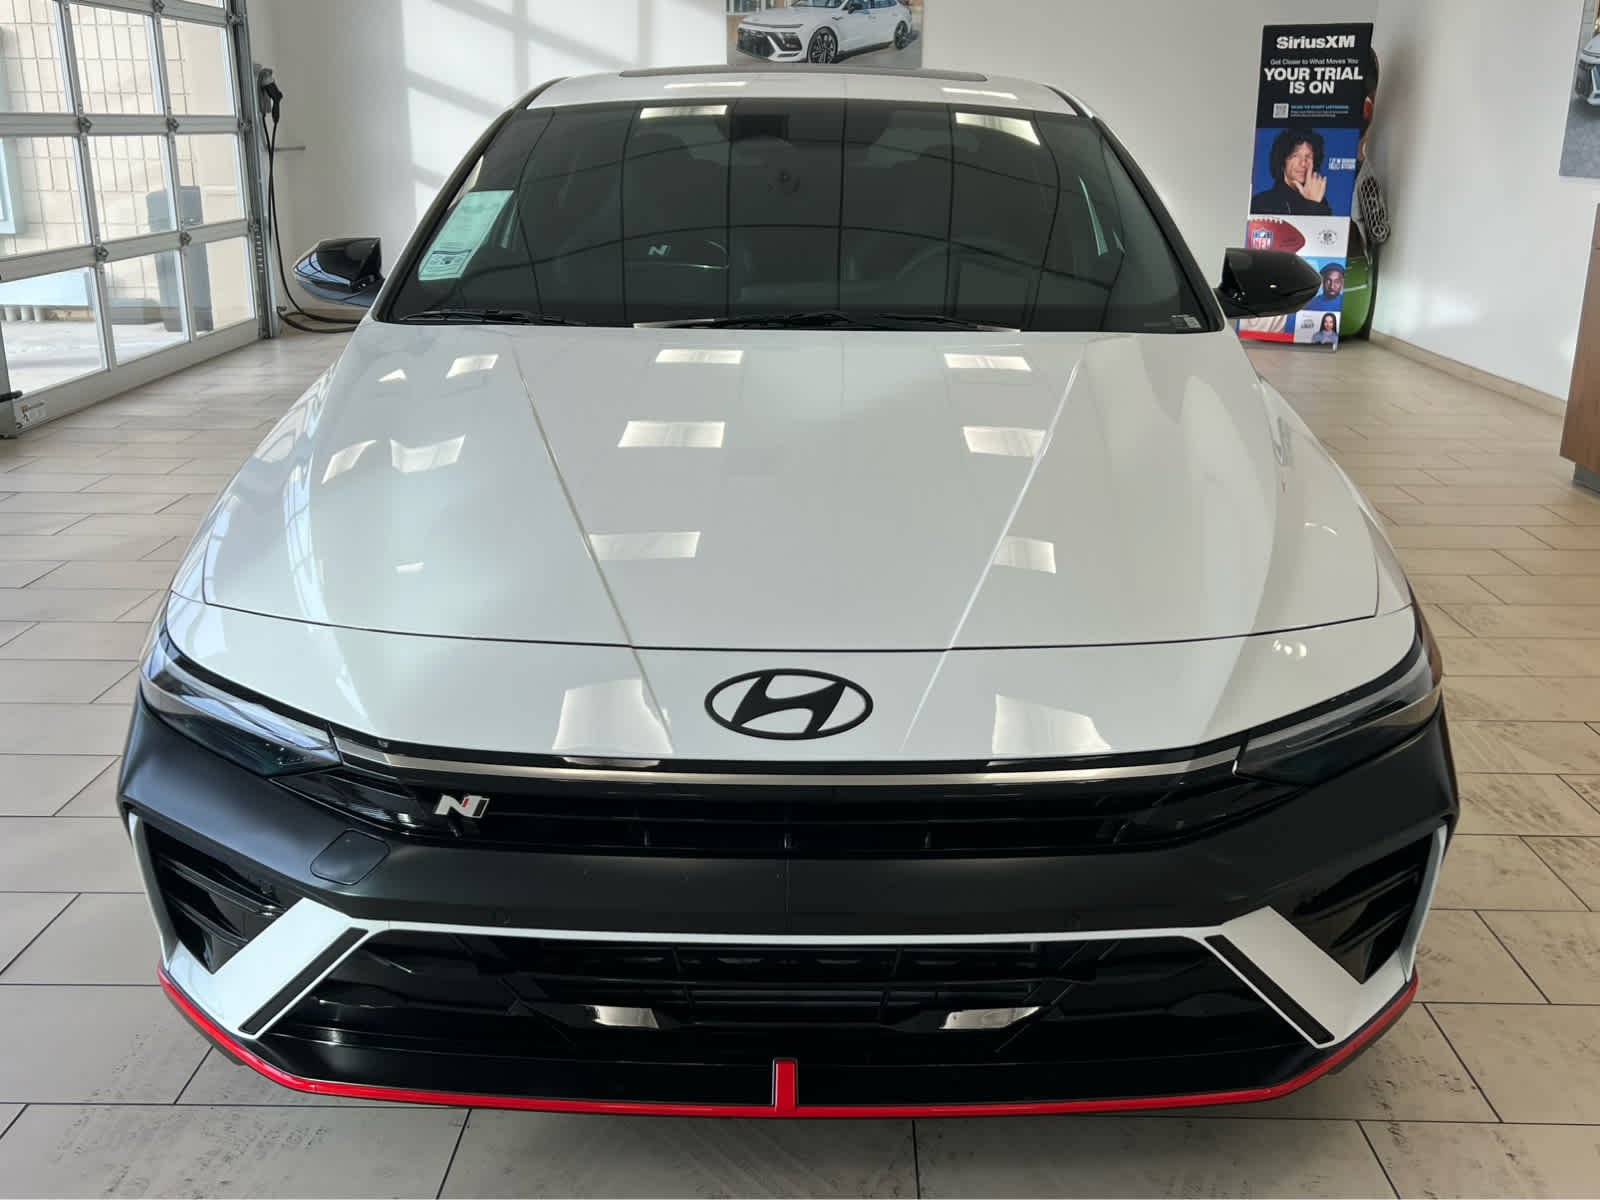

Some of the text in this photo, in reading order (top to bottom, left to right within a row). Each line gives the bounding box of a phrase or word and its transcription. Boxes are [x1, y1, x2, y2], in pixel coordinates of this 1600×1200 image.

[1276, 35, 1355, 49] SiriusXM
[1264, 67, 1363, 80] YOUR TRIAL
[1289, 81, 1335, 94] IS ON
